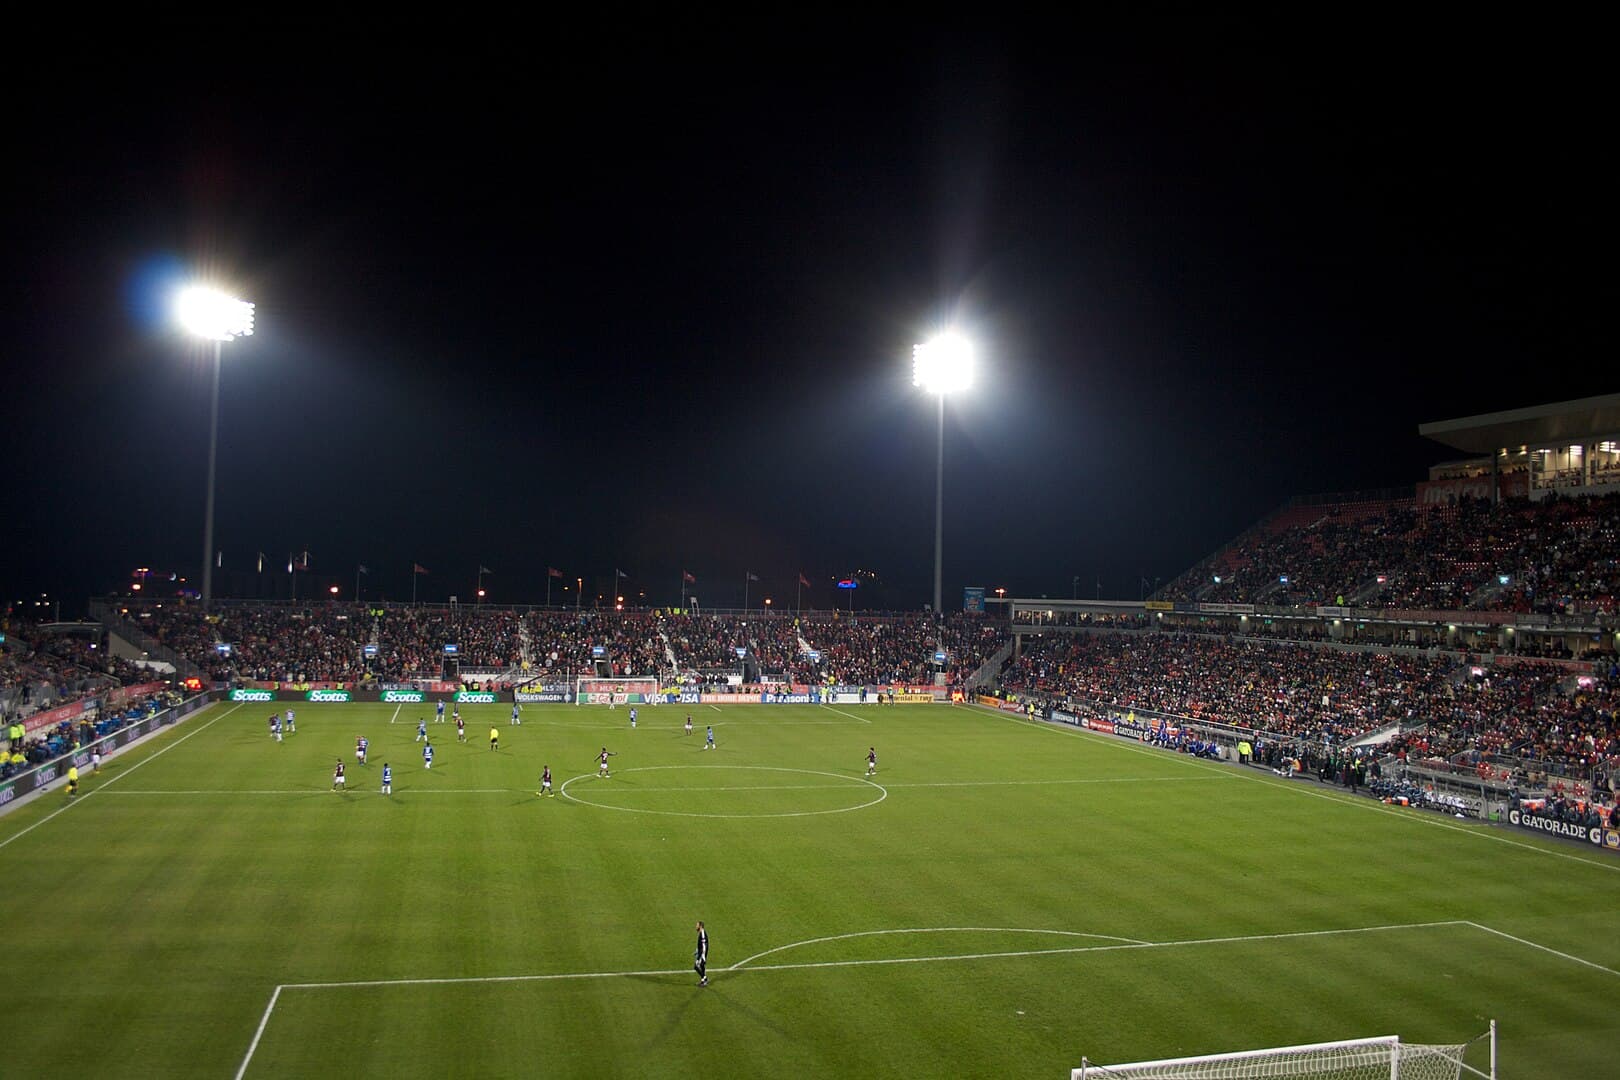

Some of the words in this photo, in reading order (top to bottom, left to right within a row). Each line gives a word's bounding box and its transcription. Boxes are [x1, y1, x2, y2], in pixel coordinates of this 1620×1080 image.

[232, 690, 272, 702] Scotts
[310, 690, 349, 702] Scotts
[385, 691, 423, 703] Scotts
[457, 691, 496, 703] Scotts
[599, 694, 626, 703] Carol
[644, 694, 668, 703] VISA
[35, 767, 56, 787] Scotts
[0, 786, 14, 804] otts
[1509, 810, 1520, 825] G
[1521, 814, 1586, 839] GATORADE
[1589, 827, 1601, 844] G
